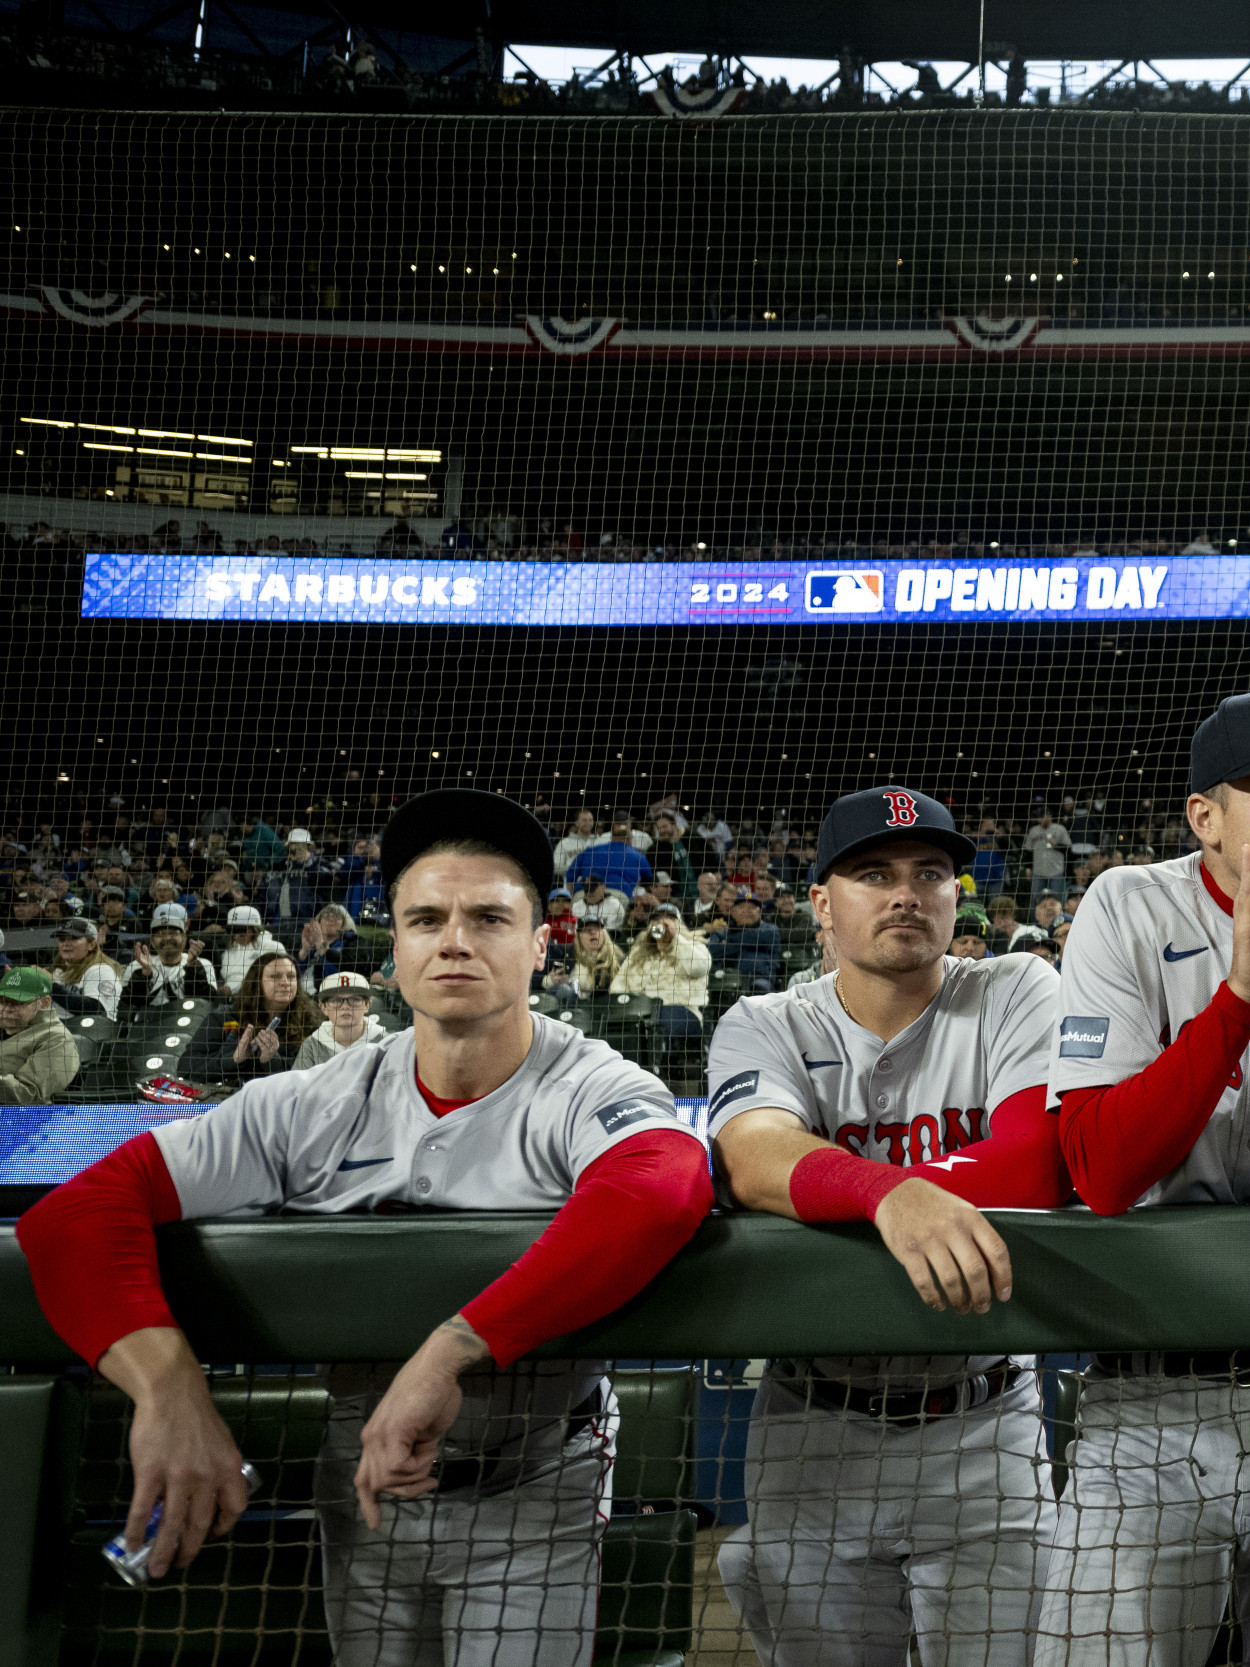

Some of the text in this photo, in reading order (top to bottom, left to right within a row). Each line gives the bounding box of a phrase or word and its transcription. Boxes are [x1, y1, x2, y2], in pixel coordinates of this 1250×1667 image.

[205, 572, 478, 605] STARBUCKS
[690, 566, 1168, 612] 2024 OPENING DAY
[882, 791, 919, 826] B
